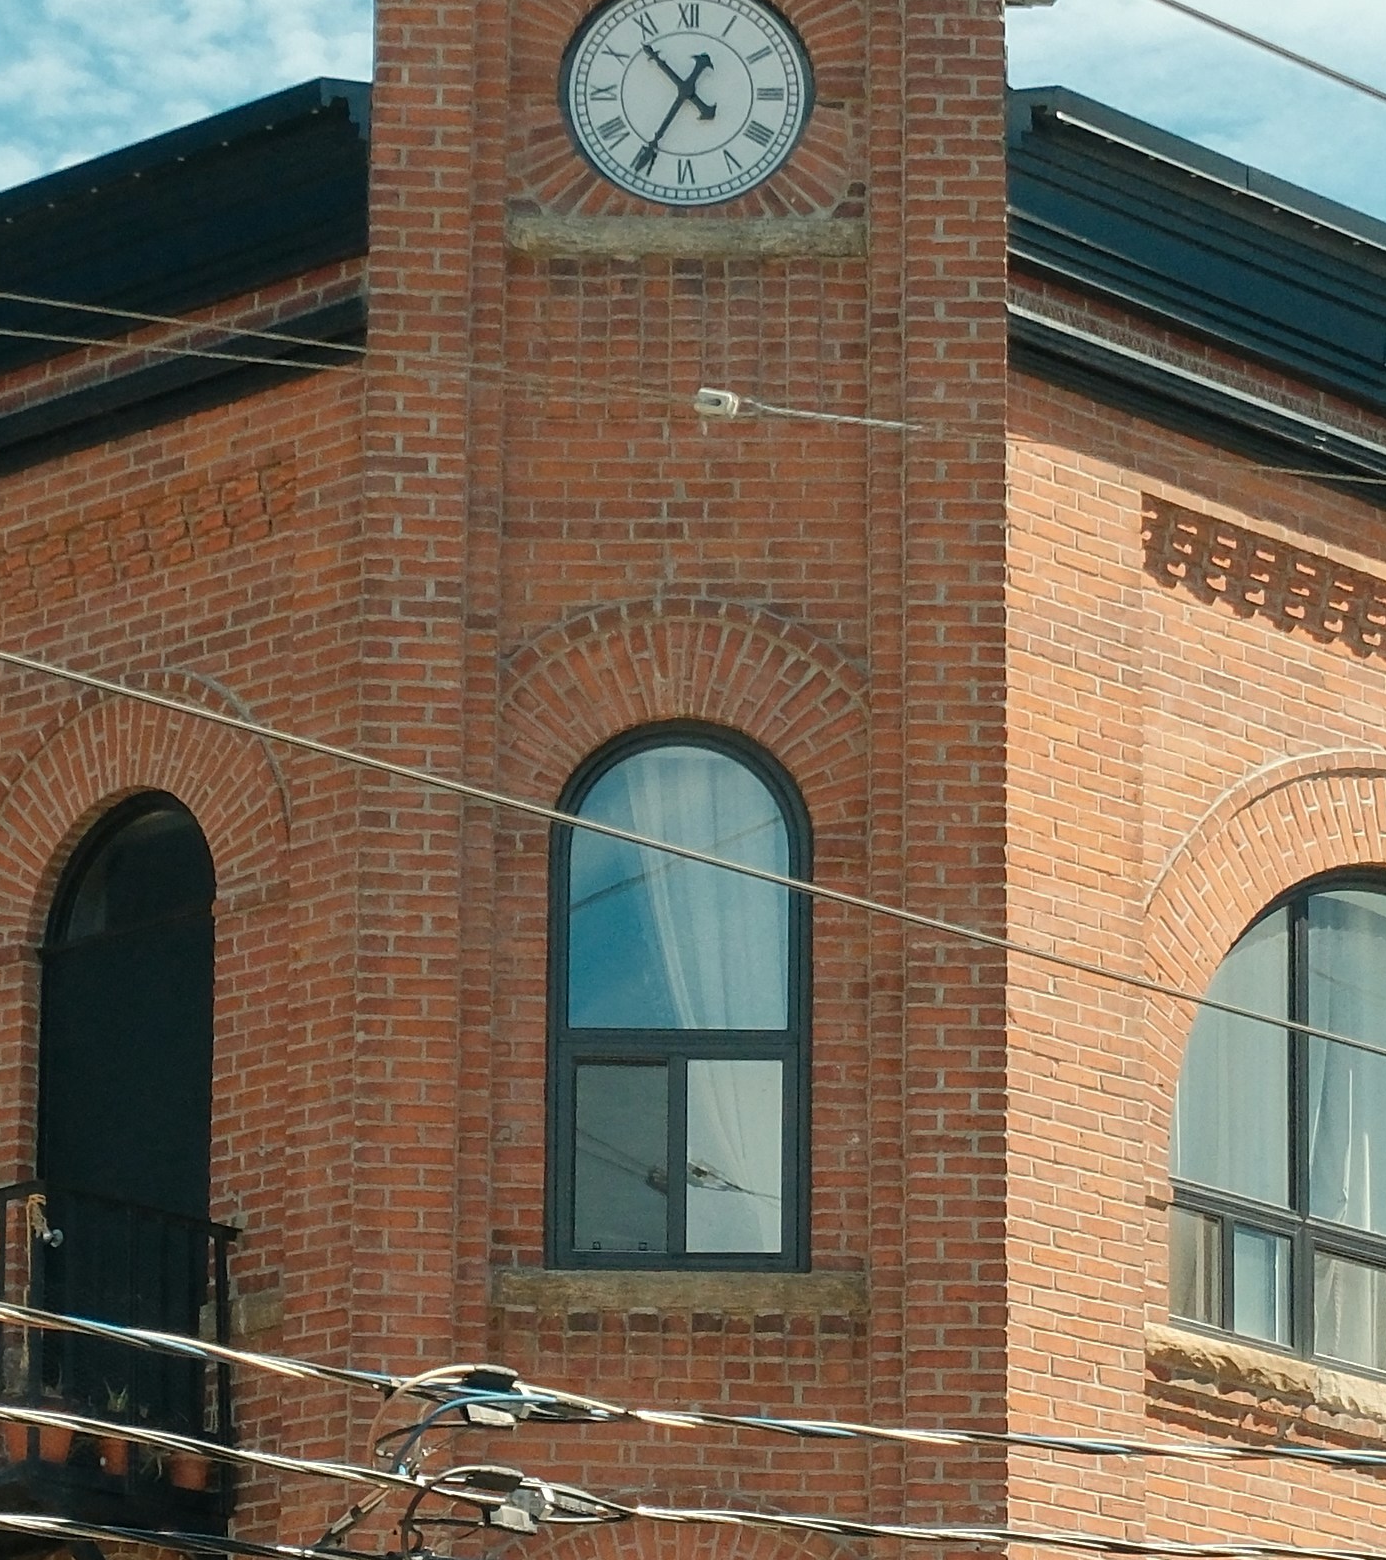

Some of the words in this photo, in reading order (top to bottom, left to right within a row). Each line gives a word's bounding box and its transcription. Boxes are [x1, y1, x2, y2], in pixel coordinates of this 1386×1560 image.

[633, 11, 659, 39] XI
[678, 3, 700, 28] XII
[601, 43, 630, 66] X
[746, 46, 773, 65] II
[589, 85, 617, 101] IX
[757, 87, 785, 101] III
[723, 149, 743, 175] V
